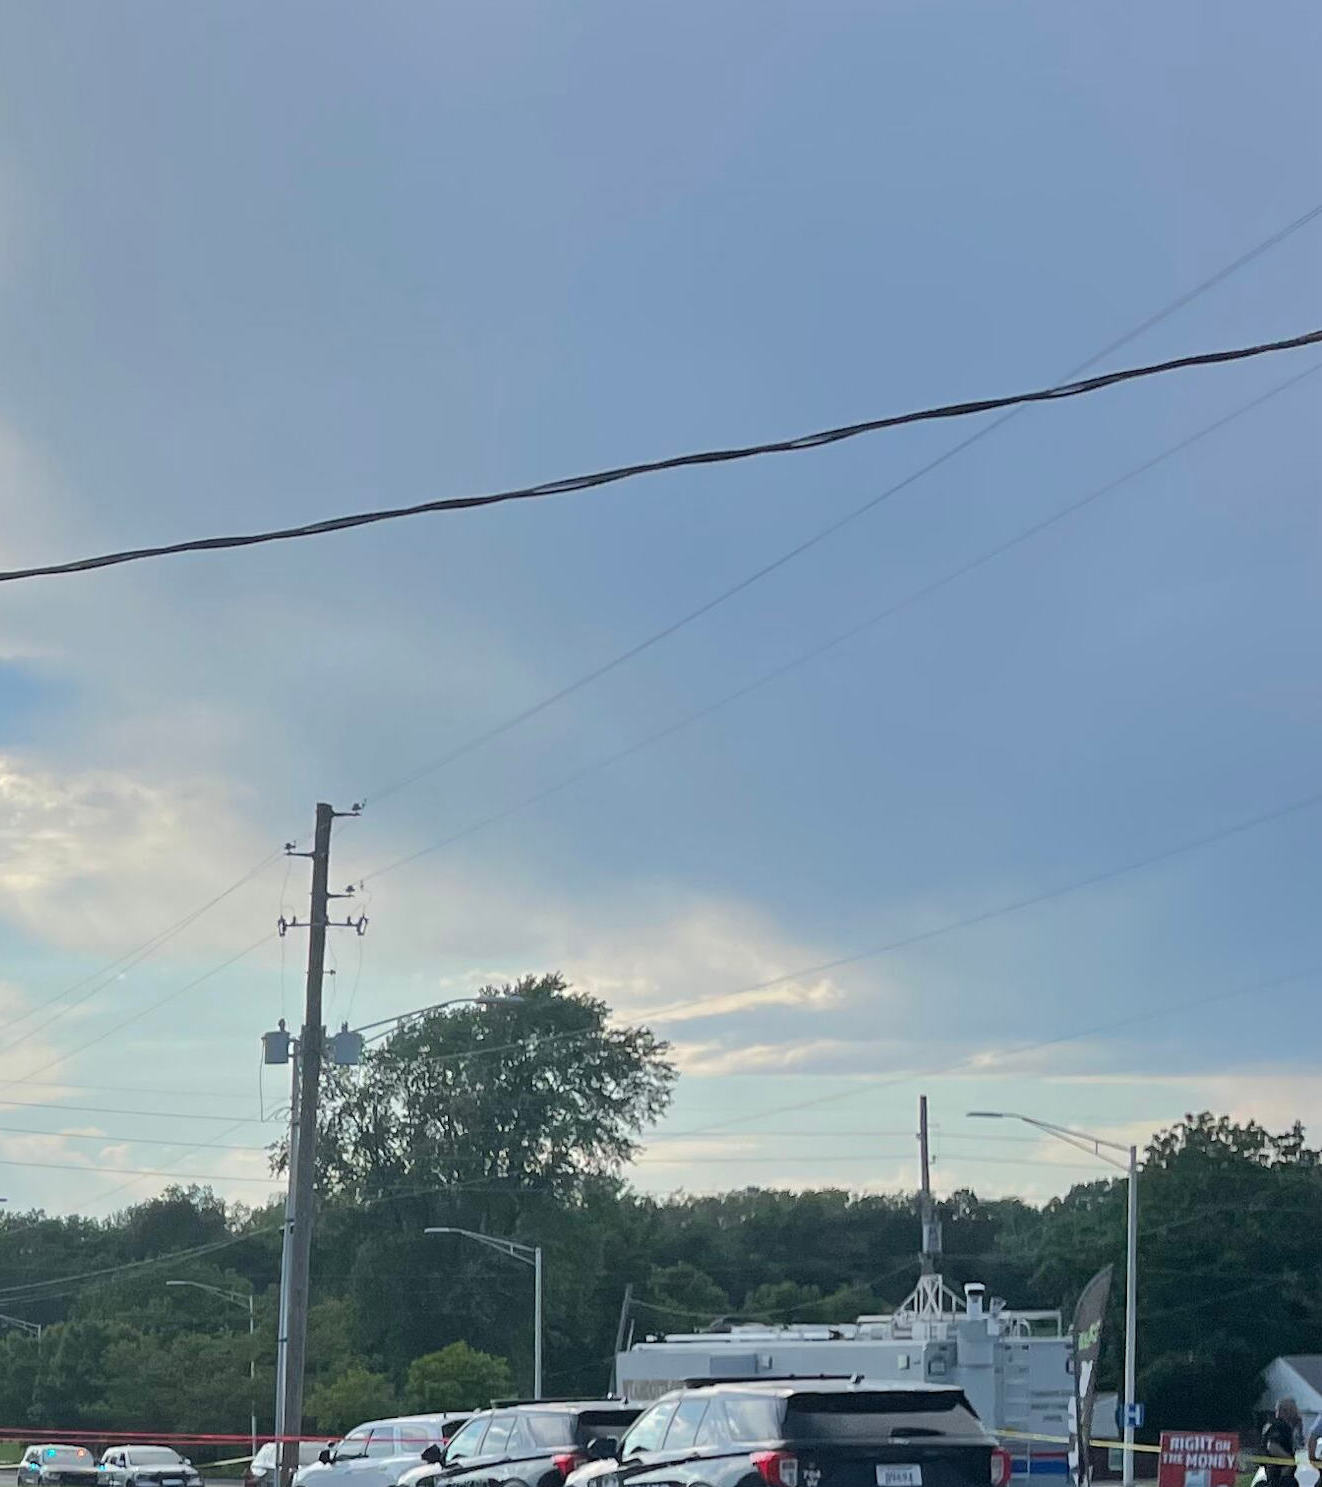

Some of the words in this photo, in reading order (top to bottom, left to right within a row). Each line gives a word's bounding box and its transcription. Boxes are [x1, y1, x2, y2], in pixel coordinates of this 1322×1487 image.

[1169, 1435, 1214, 1451] RIGHT
[1162, 1453, 1183, 1465] THE
[1184, 1453, 1236, 1469] MONEY
